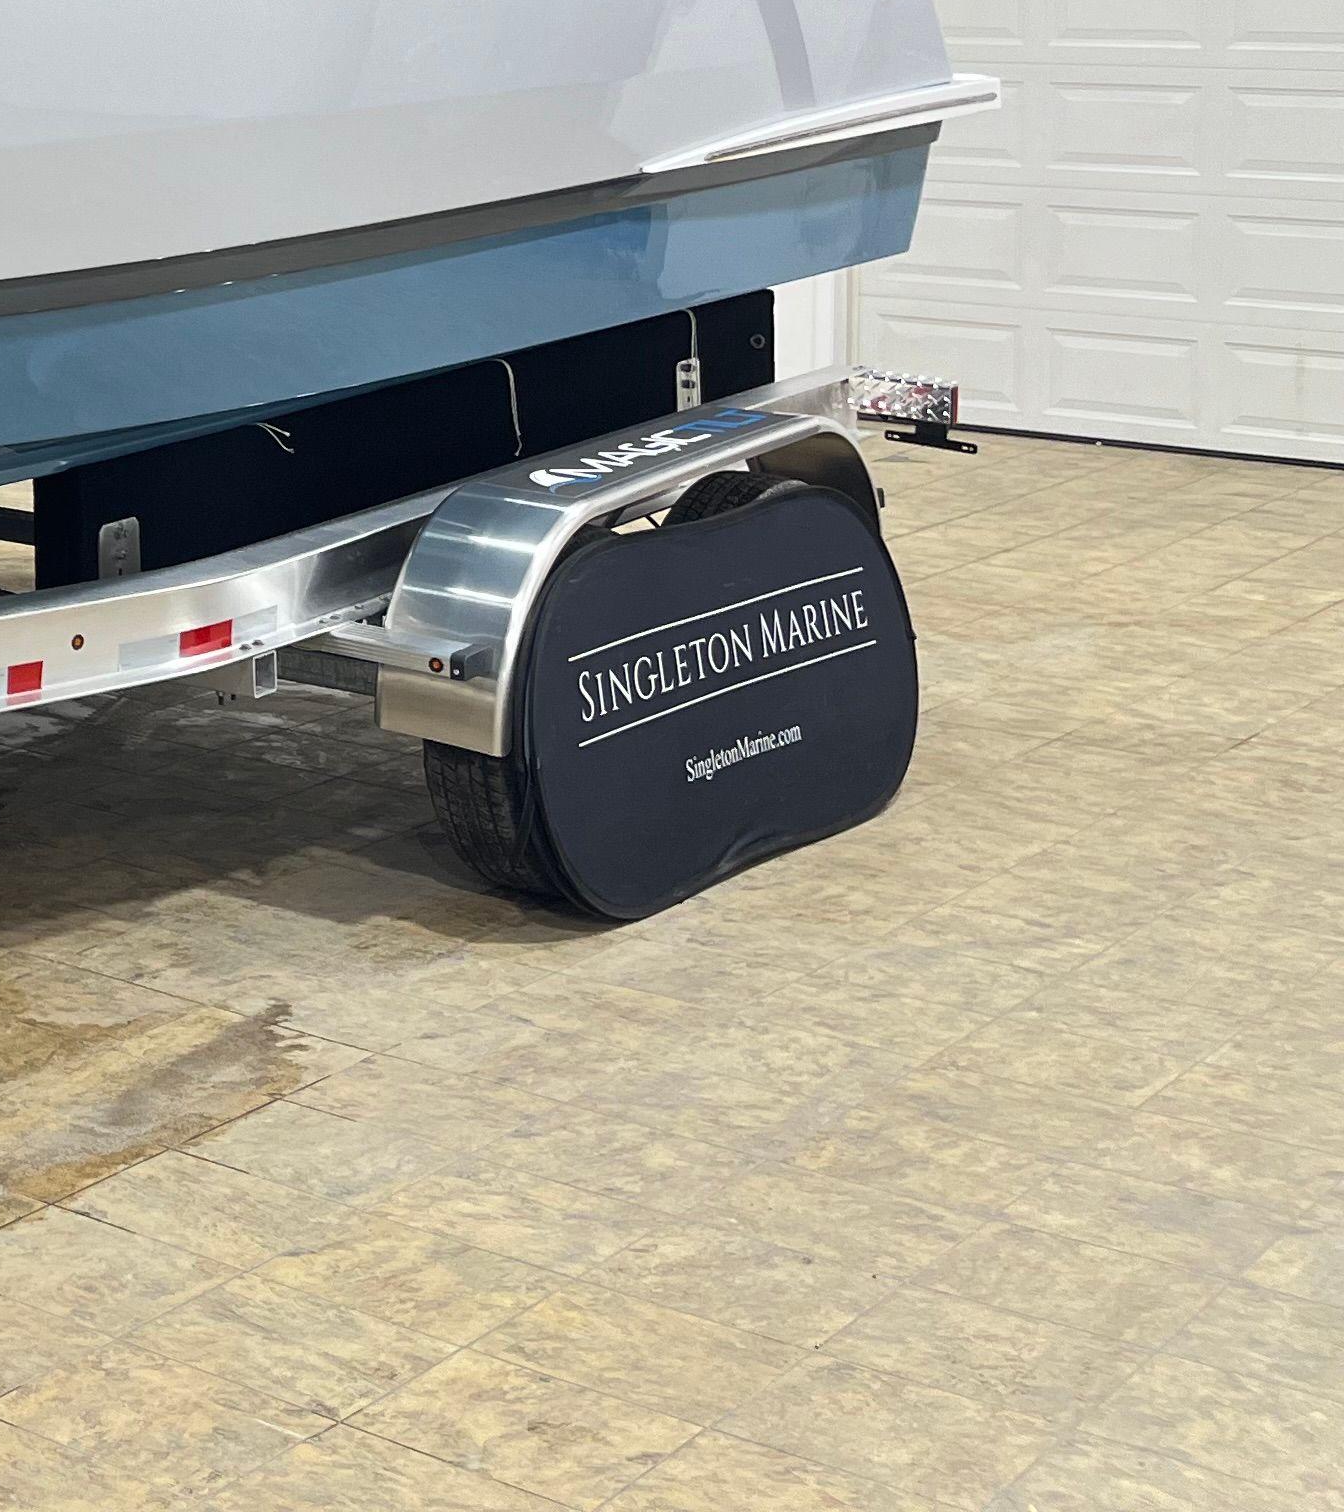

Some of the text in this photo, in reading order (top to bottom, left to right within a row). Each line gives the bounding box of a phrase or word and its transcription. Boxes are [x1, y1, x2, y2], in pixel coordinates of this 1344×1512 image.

[578, 589, 869, 723] SINGLETON MARINE
[685, 724, 803, 782] SingletonMarine.com
